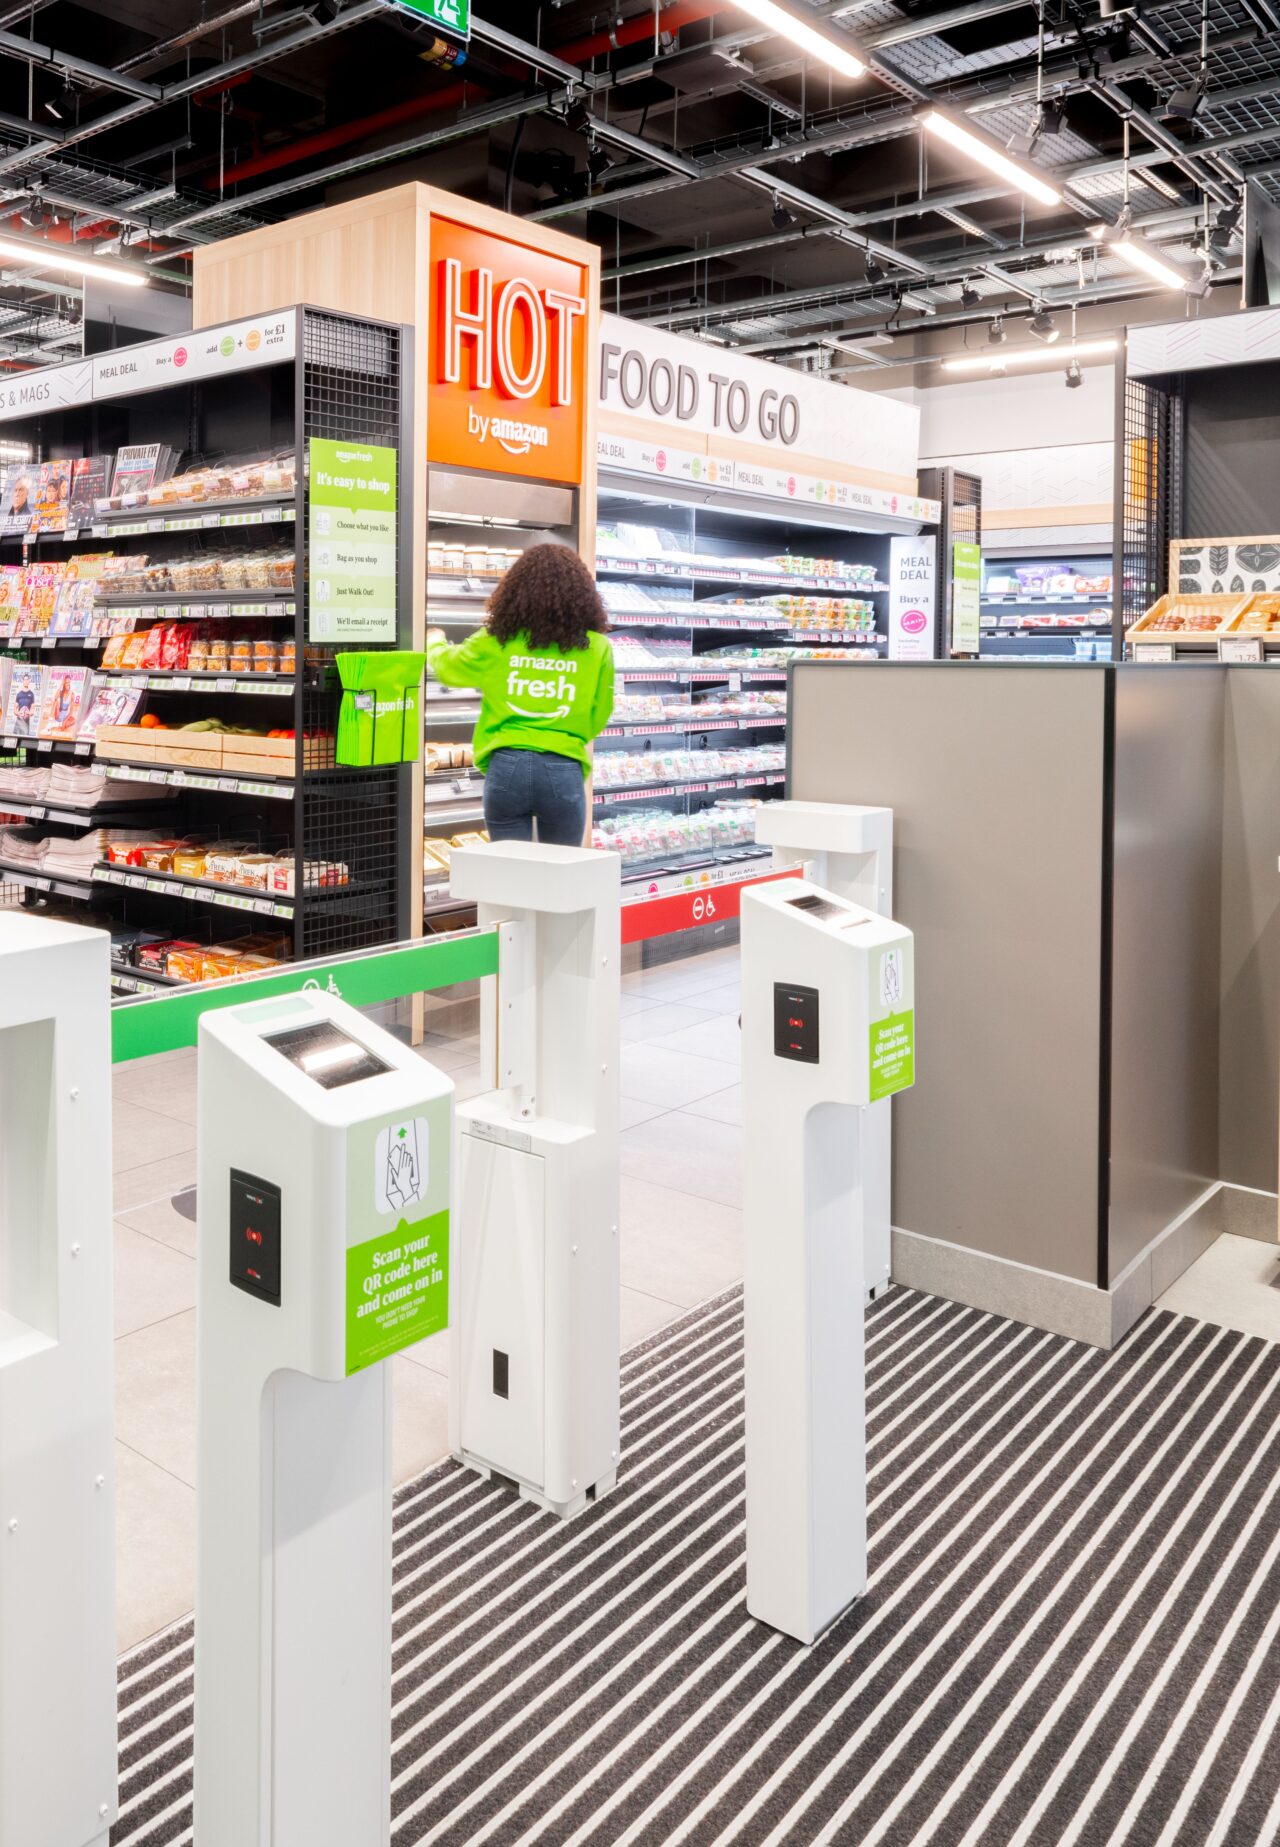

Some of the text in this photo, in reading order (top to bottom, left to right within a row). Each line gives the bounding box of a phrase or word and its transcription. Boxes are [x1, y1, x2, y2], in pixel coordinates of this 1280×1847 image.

[264, 324, 285, 336] for £1
[438, 258, 585, 407] HOT
[266, 336, 284, 345] extra
[206, 345, 218, 354] add
[156, 357, 167, 366] Buy
[99, 362, 138, 380] MEAL DEAL
[9, 391, 16, 407] &
[20, 383, 50, 405] MAGS
[600, 343, 800, 445] FOOD TO GO
[468, 405, 548, 447] by amazon
[122, 446, 147, 460] PRIVATE
[597, 442, 626, 459] EAL DEAL
[317, 471, 390, 495] It's easy to shop
[738, 471, 751, 484] MEAL
[751, 474, 764, 487] DEAL
[336, 520, 355, 529] Choose
[356, 522, 368, 530] what
[380, 524, 389, 532] like
[336, 553, 347, 563] Bag
[354, 556, 364, 564] you
[365, 555, 378, 565] shop
[900, 556, 932, 567] MEAL
[900, 570, 930, 580] DEAL
[336, 587, 347, 596] Just
[348, 587, 362, 596] Walk
[900, 595, 920, 605] Buy
[336, 617, 350, 625] We'll
[351, 617, 366, 625] email
[370, 618, 388, 627] receipt
[509, 655, 577, 673] amazon
[506, 670, 576, 701] fresh
[879, 1023, 904, 1040] Scan your
[875, 1035, 908, 1056] QR code here
[872, 1044, 911, 1069] and come on in
[372, 1234, 430, 1270] Scan your
[363, 1252, 438, 1295] QR code here
[356, 1268, 443, 1318] and come on in
